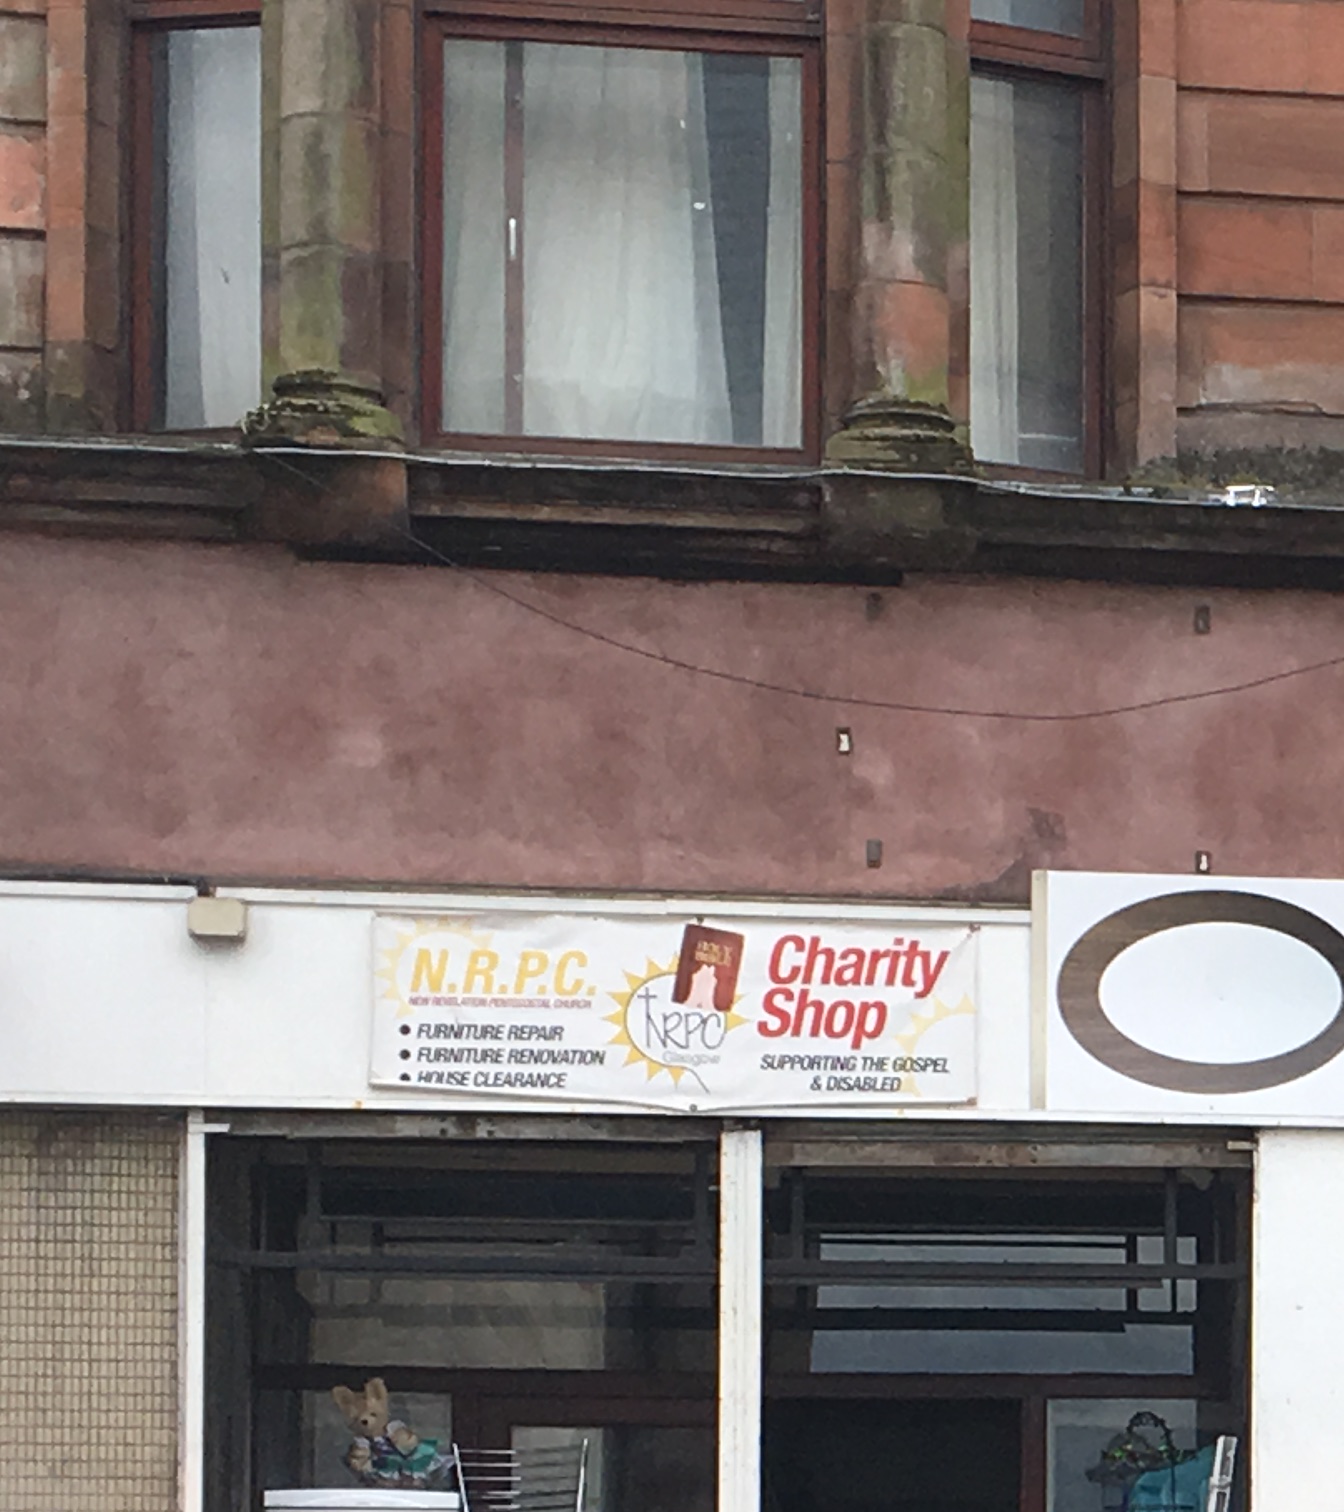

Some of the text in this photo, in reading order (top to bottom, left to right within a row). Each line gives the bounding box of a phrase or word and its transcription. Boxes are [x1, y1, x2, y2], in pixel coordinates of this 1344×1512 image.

[409, 947, 598, 997] N.R.P.C.
[768, 934, 951, 999] Charity
[553, 998, 593, 1010] CHURCH
[757, 987, 888, 1050] Shop
[416, 1023, 565, 1042] FURNITURE REPAIR
[416, 1046, 607, 1066] FURNITURE RENOVATION
[759, 1053, 951, 1074] SUPPORTING THE GOSPEL
[416, 1070, 568, 1089] HOUSE CLEARANCE
[809, 1075, 902, 1092] & DISABLED
